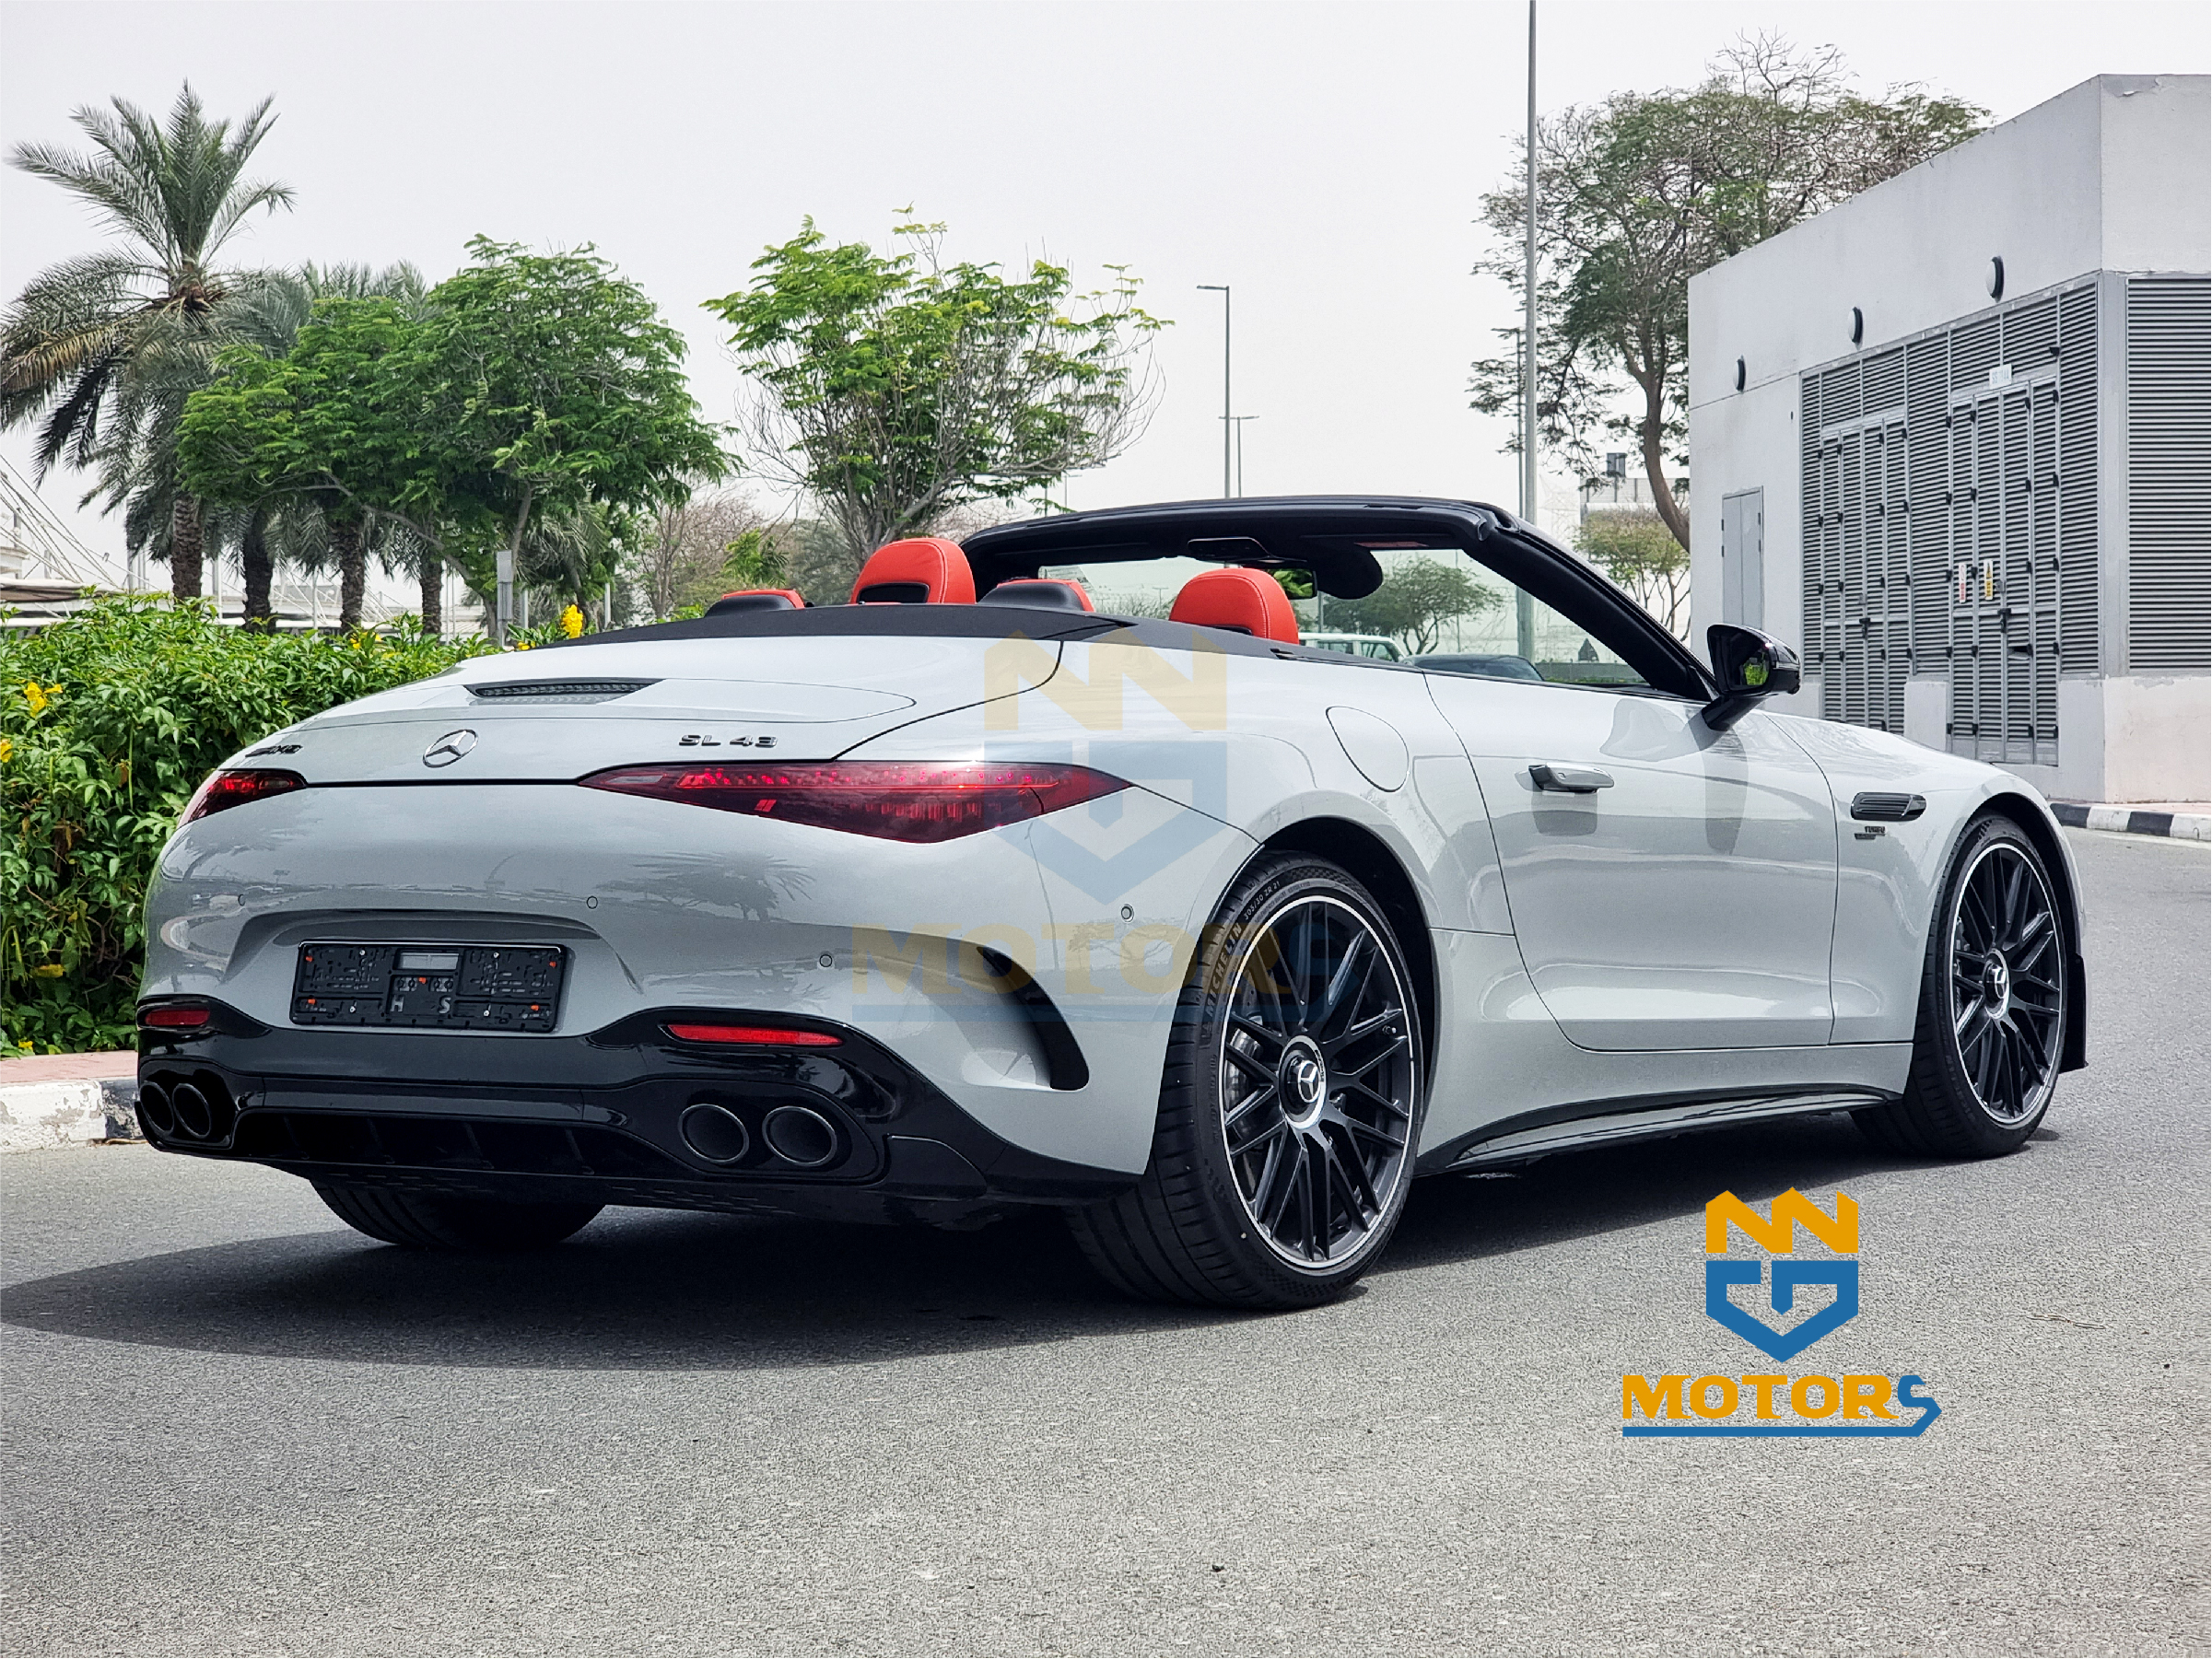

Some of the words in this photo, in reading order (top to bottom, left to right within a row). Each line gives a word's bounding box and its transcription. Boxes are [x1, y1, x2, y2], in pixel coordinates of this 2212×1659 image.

[678, 734, 721, 746] SL
[729, 735, 778, 748] 43
[1205, 922, 1242, 1017] MICHELIN
[1243, 894, 1264, 920] 305/30
[1272, 881, 1281, 890] 21
